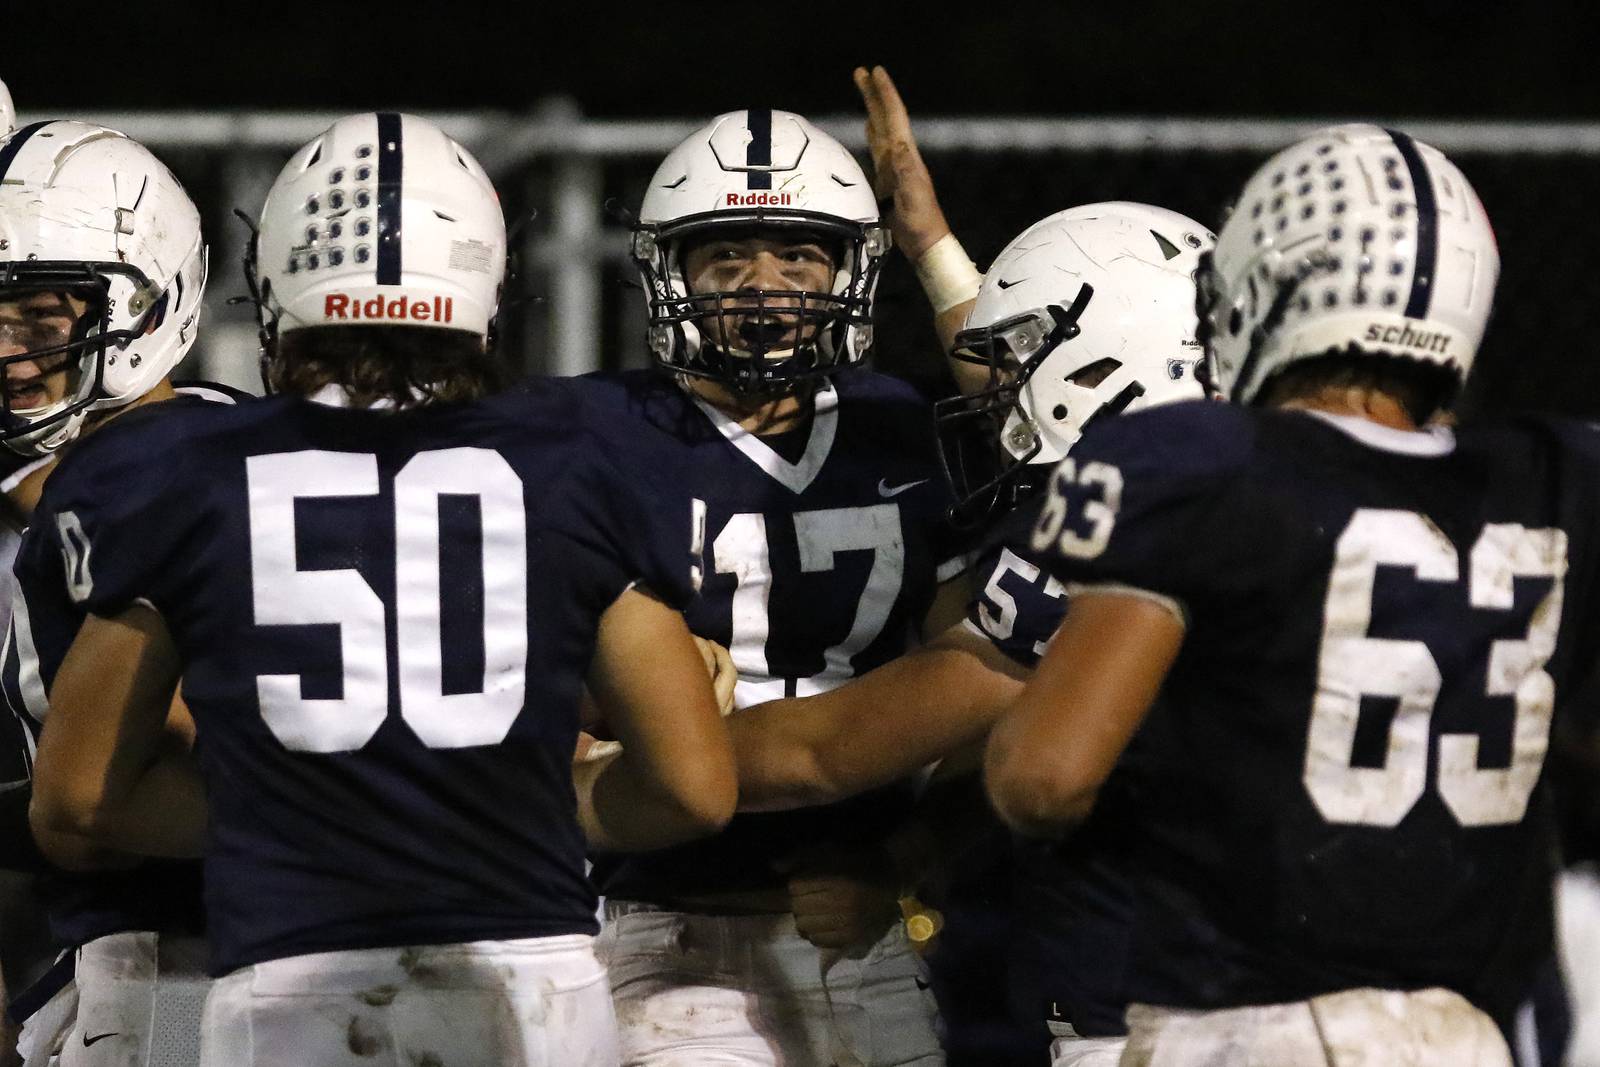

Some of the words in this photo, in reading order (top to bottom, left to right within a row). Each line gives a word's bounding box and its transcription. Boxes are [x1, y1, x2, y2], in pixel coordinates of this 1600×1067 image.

[726, 192, 791, 206] Riddell
[324, 293, 454, 323] Riddell
[1030, 457, 1125, 560] 63
[245, 446, 529, 754] 50
[712, 503, 906, 710] 17
[1302, 506, 1570, 829] 63
